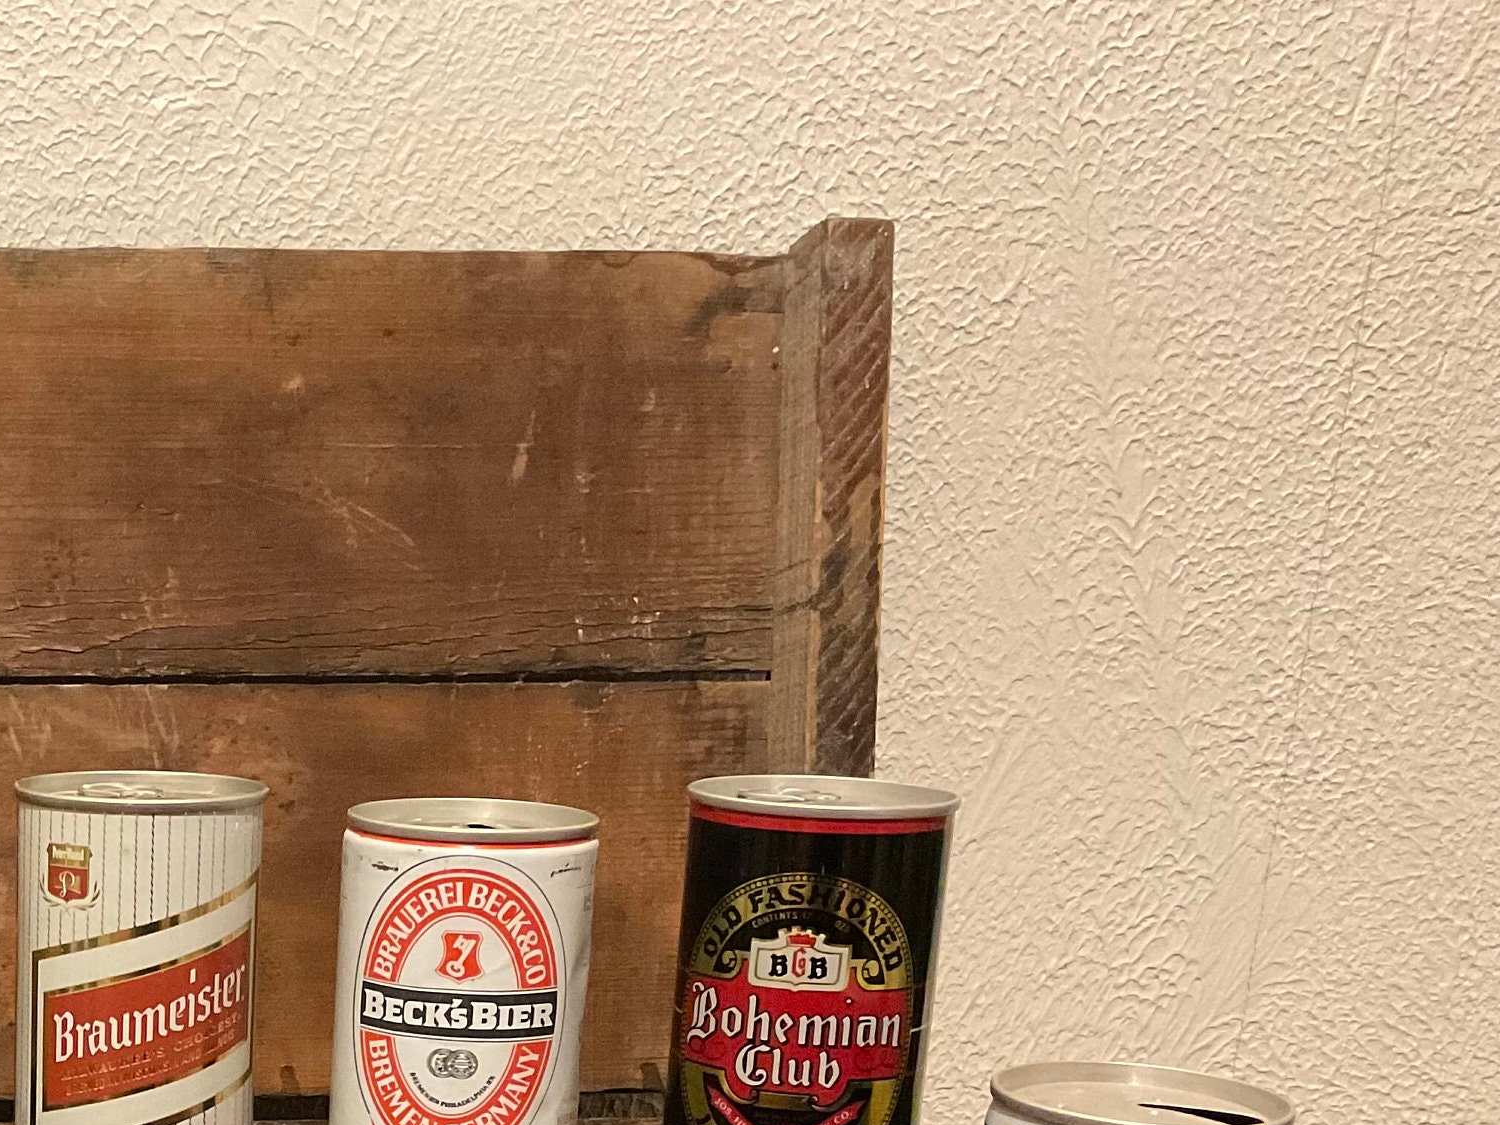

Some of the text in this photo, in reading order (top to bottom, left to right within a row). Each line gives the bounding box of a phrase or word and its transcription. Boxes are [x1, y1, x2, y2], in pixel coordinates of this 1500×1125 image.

[373, 881, 465, 980] BRAUEREI
[703, 883, 903, 973] OLD FASHIONED
[752, 911, 799, 929] CONTENTS
[53, 964, 246, 1064] Braumeister
[469, 1001, 554, 1030] BIER
[686, 980, 901, 1048] Bohemian
[733, 1043, 842, 1089] Club
[833, 1109, 854, 1125] CO.
